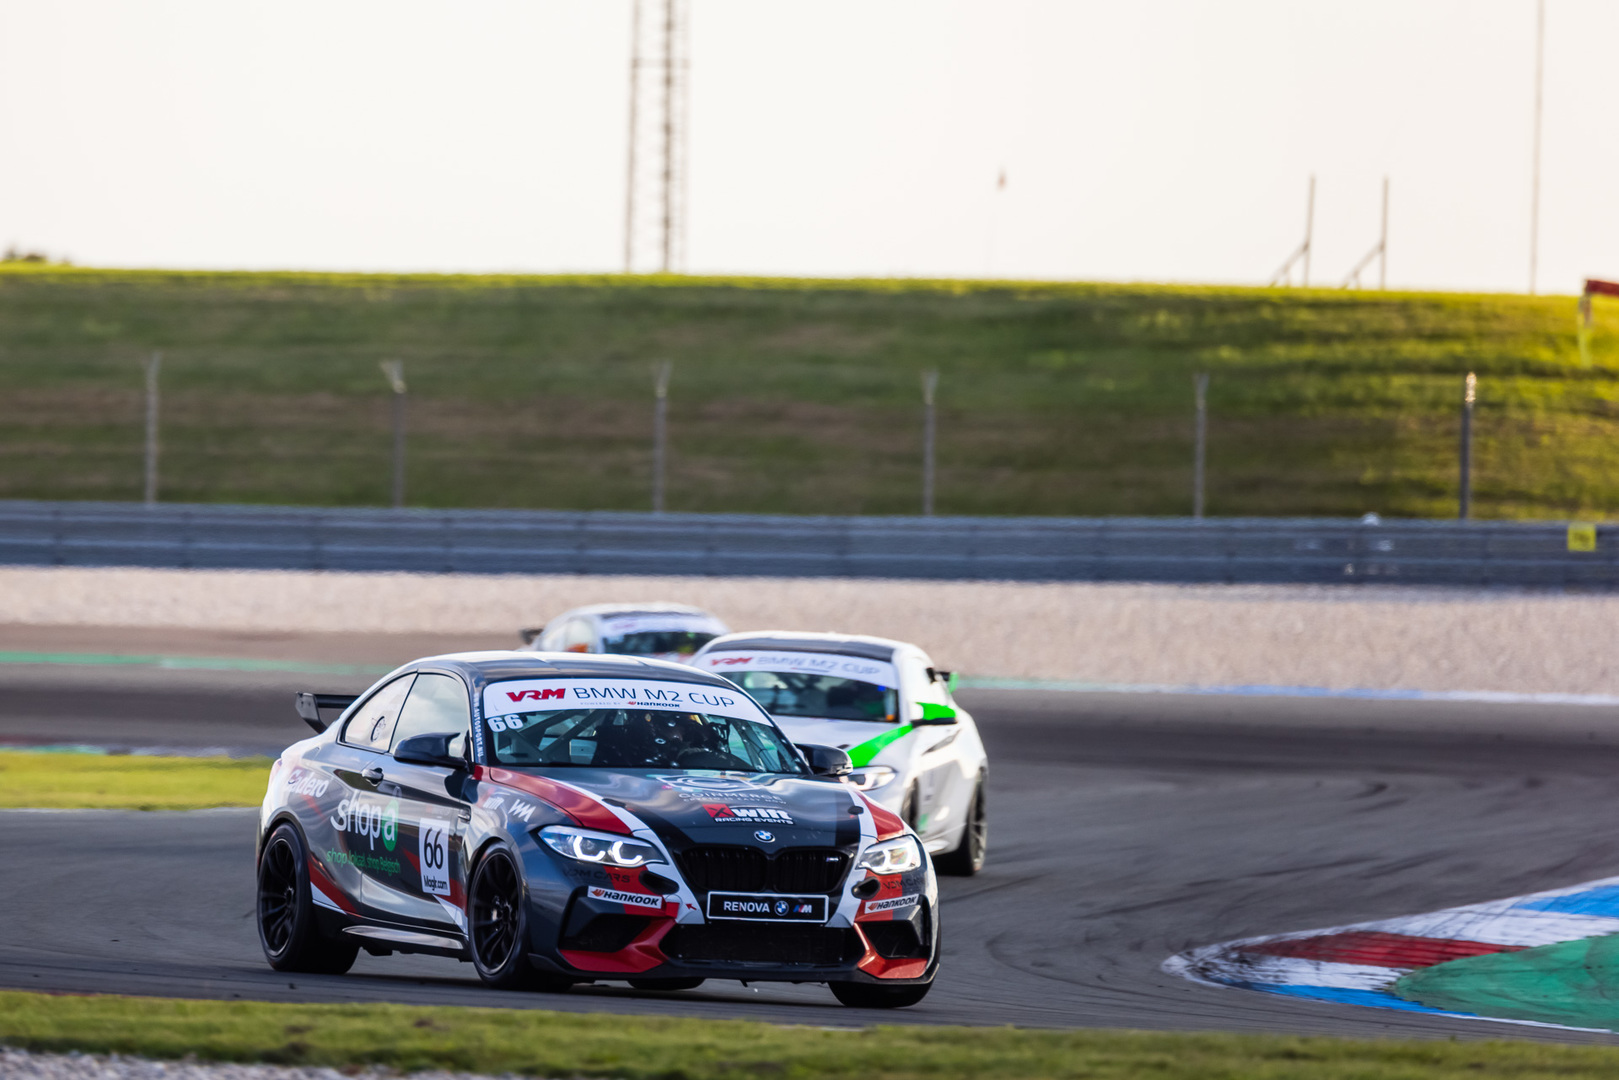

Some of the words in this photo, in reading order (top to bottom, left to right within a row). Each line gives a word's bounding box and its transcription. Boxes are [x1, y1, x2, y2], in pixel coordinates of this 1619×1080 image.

[757, 657, 805, 666] BMW
[842, 663, 880, 675] CUP
[506, 688, 566, 702] VRM
[573, 687, 637, 699] BMW
[644, 689, 683, 702] M2
[689, 692, 735, 707] CUP
[487, 713, 523, 733] 66
[326, 848, 347, 868] shop
[424, 827, 443, 870] 66
[723, 901, 770, 913] RENOVA
